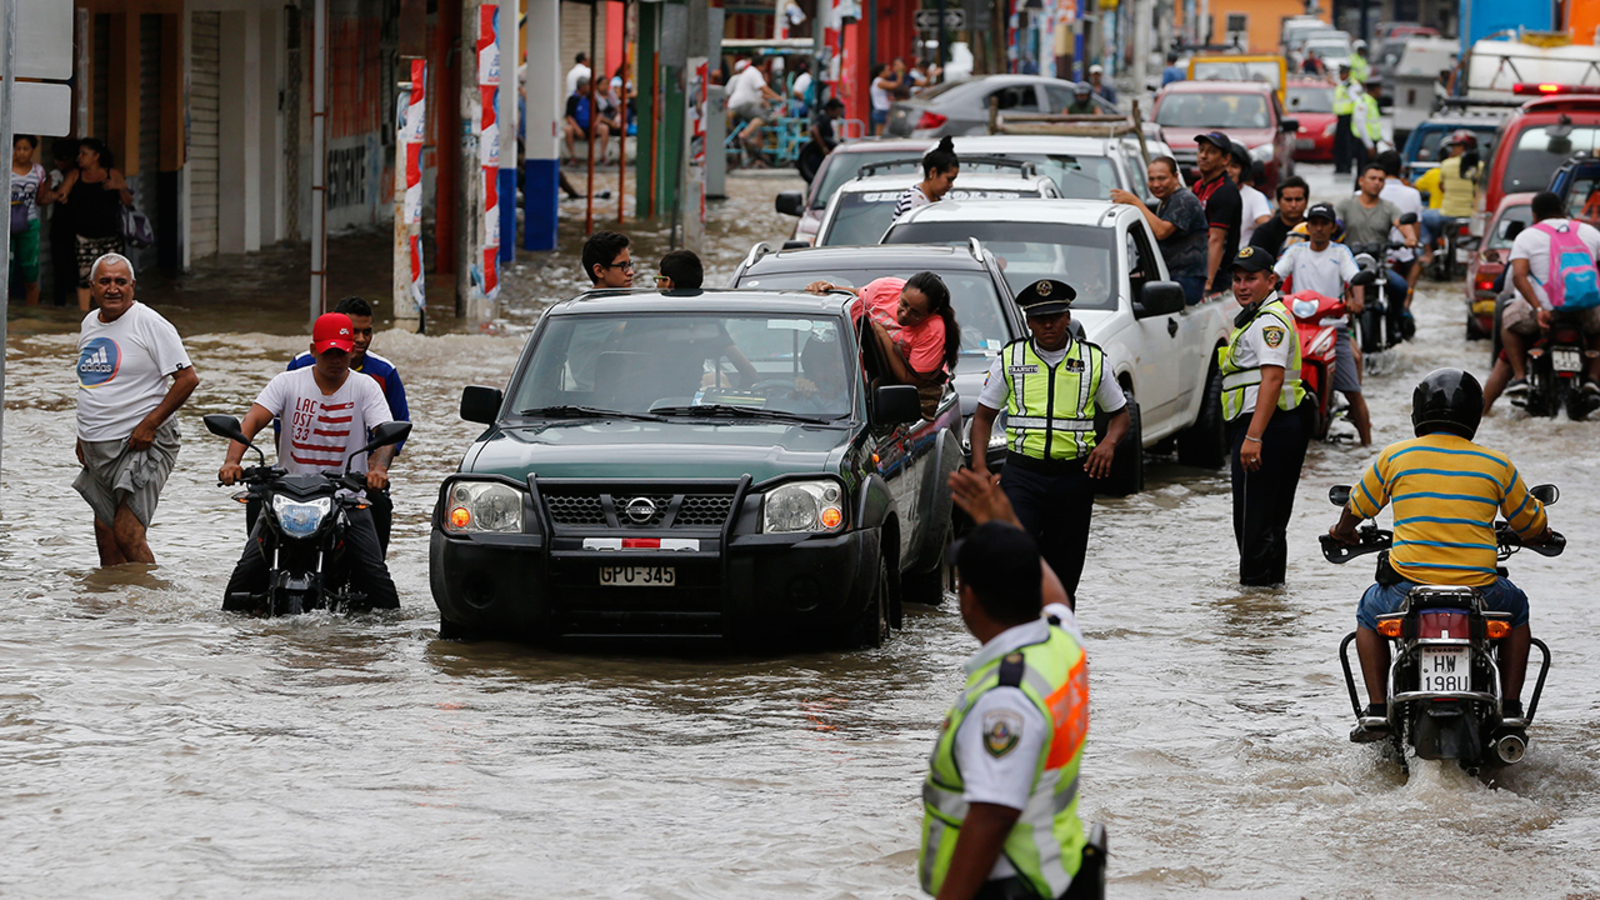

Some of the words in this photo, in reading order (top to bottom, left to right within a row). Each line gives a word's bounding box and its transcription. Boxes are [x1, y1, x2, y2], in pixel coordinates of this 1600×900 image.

[80, 362, 112, 374] adidas
[295, 396, 318, 414] LAC
[292, 411, 314, 427] OST
[602, 566, 674, 584] GPU-345
[1434, 655, 1456, 672] HW
